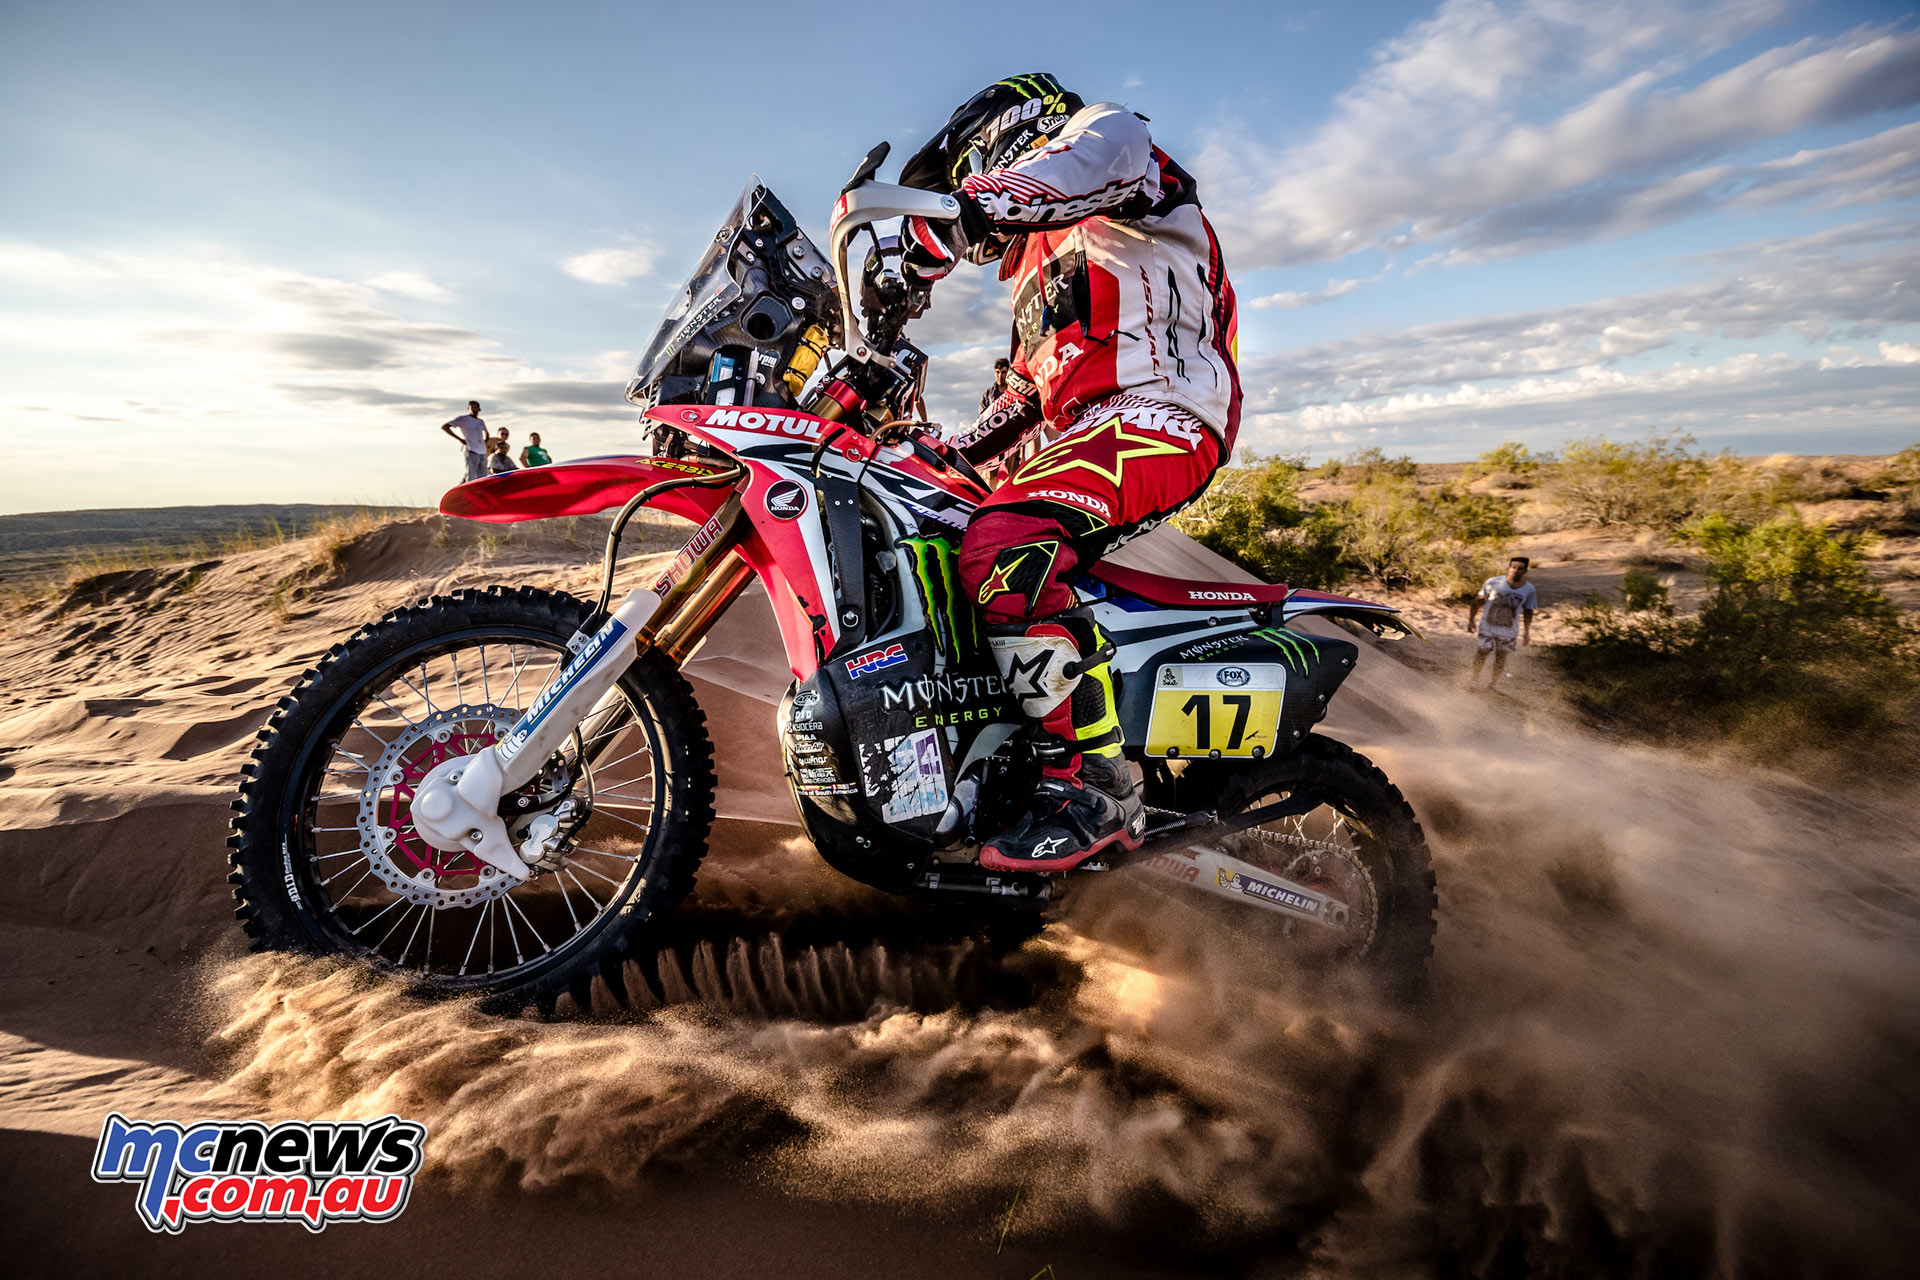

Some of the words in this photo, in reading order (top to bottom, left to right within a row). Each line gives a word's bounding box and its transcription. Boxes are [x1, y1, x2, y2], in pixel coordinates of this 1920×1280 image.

[985, 92, 1067, 151] 100%
[992, 129, 1035, 170] NSTER
[1016, 273, 1069, 332] NSTER
[676, 296, 722, 343] MONSTER
[759, 353, 778, 369] rpm
[1034, 342, 1084, 388] NDA
[705, 409, 822, 438] MOTUL
[634, 458, 716, 477] ACERBIS
[1027, 489, 1111, 518] HONDA
[655, 517, 723, 599] SHOWA
[1188, 590, 1257, 602] HONDA
[845, 644, 908, 679] HRC
[1180, 634, 1249, 660] MONSTER
[527, 620, 615, 722] MICHELIN
[1224, 671, 1243, 680] FOX
[792, 721, 823, 731] KYOCERA
[915, 706, 1002, 729] ENERGY
[1181, 694, 1252, 750] 17
[1247, 881, 1318, 912] MICHELIN
